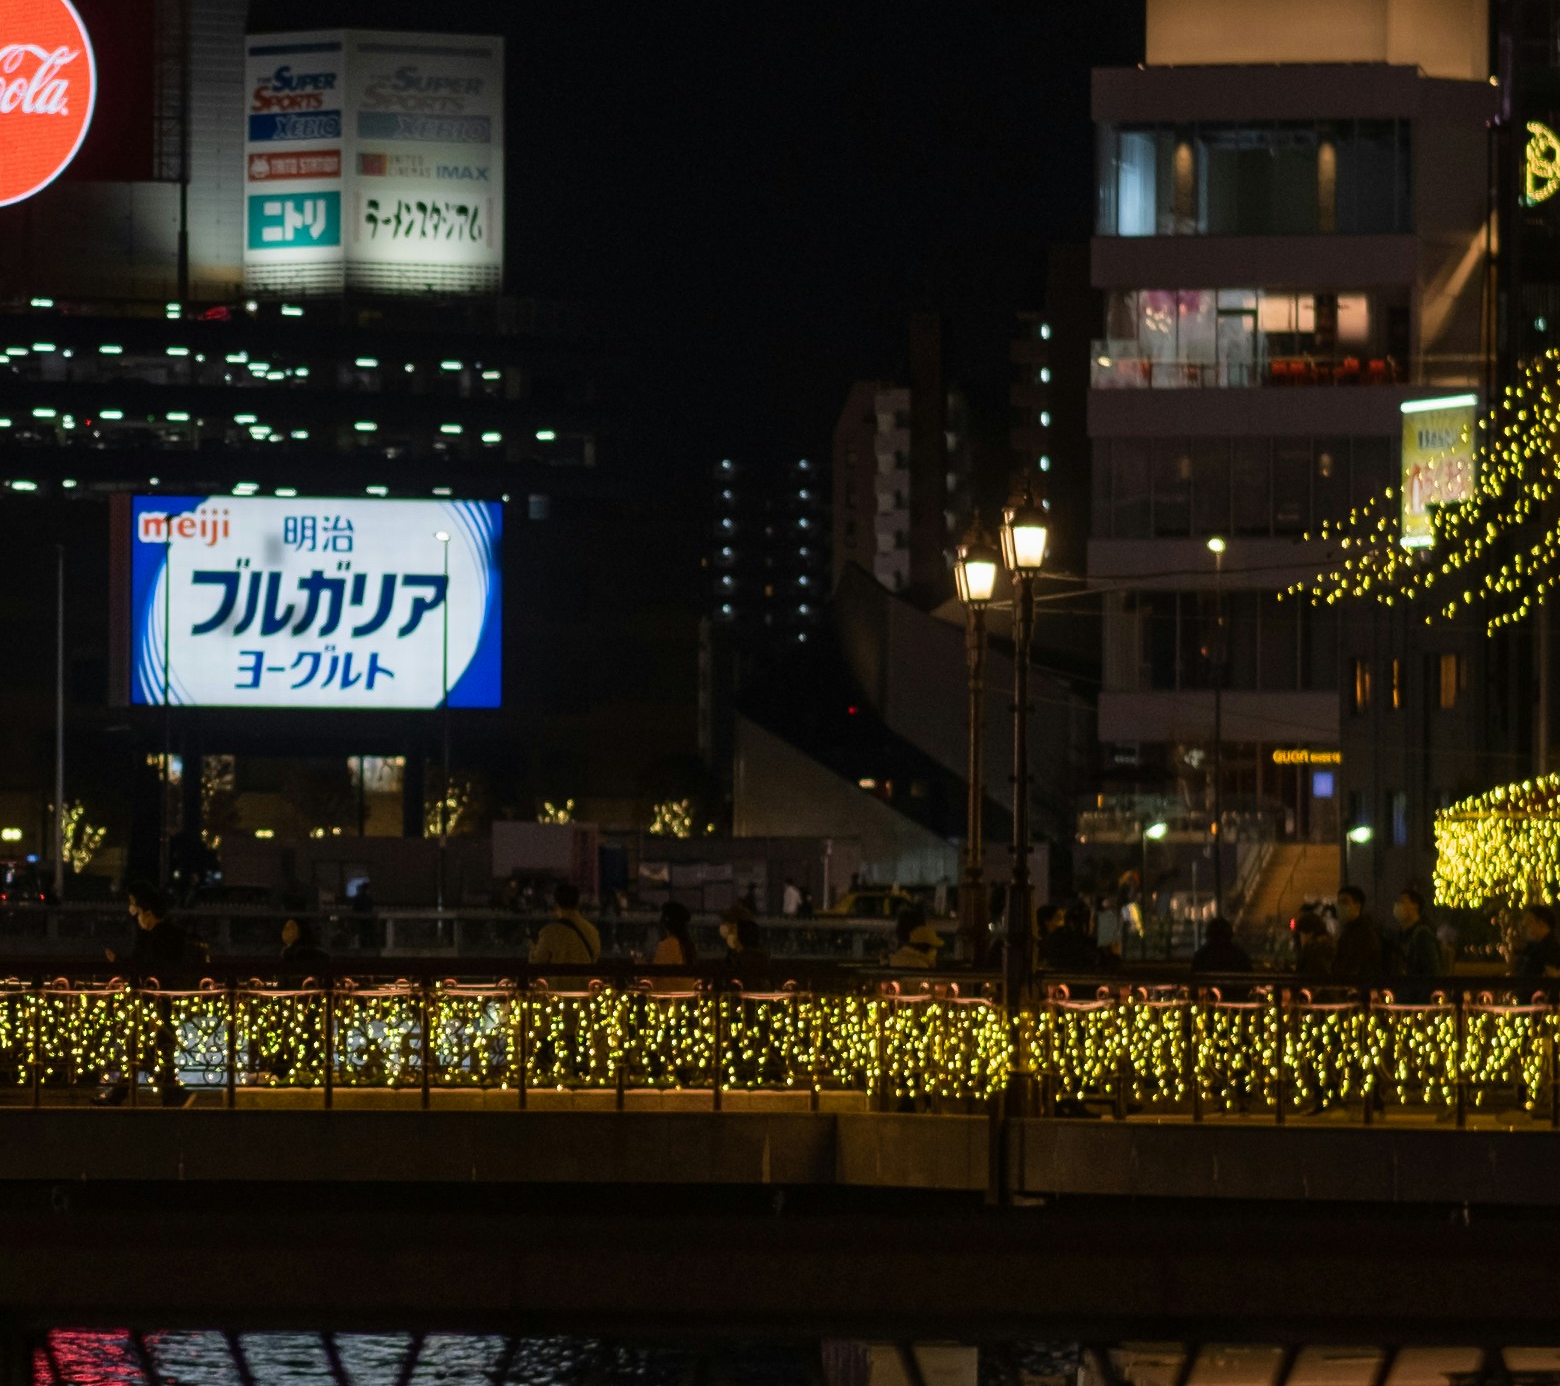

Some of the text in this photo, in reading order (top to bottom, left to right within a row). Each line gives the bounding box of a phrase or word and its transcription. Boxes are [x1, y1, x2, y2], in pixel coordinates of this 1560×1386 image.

[273, 66, 337, 92] SUPER
[253, 86, 323, 111] SPORTS
[273, 116, 339, 138] XEBIO
[437, 166, 489, 181] IMAX
[262, 199, 326, 242] ニトリ
[143, 511, 355, 554] meiji 明治
[191, 557, 449, 638] ブルガリア
[235, 644, 394, 690] ヨーグルト
